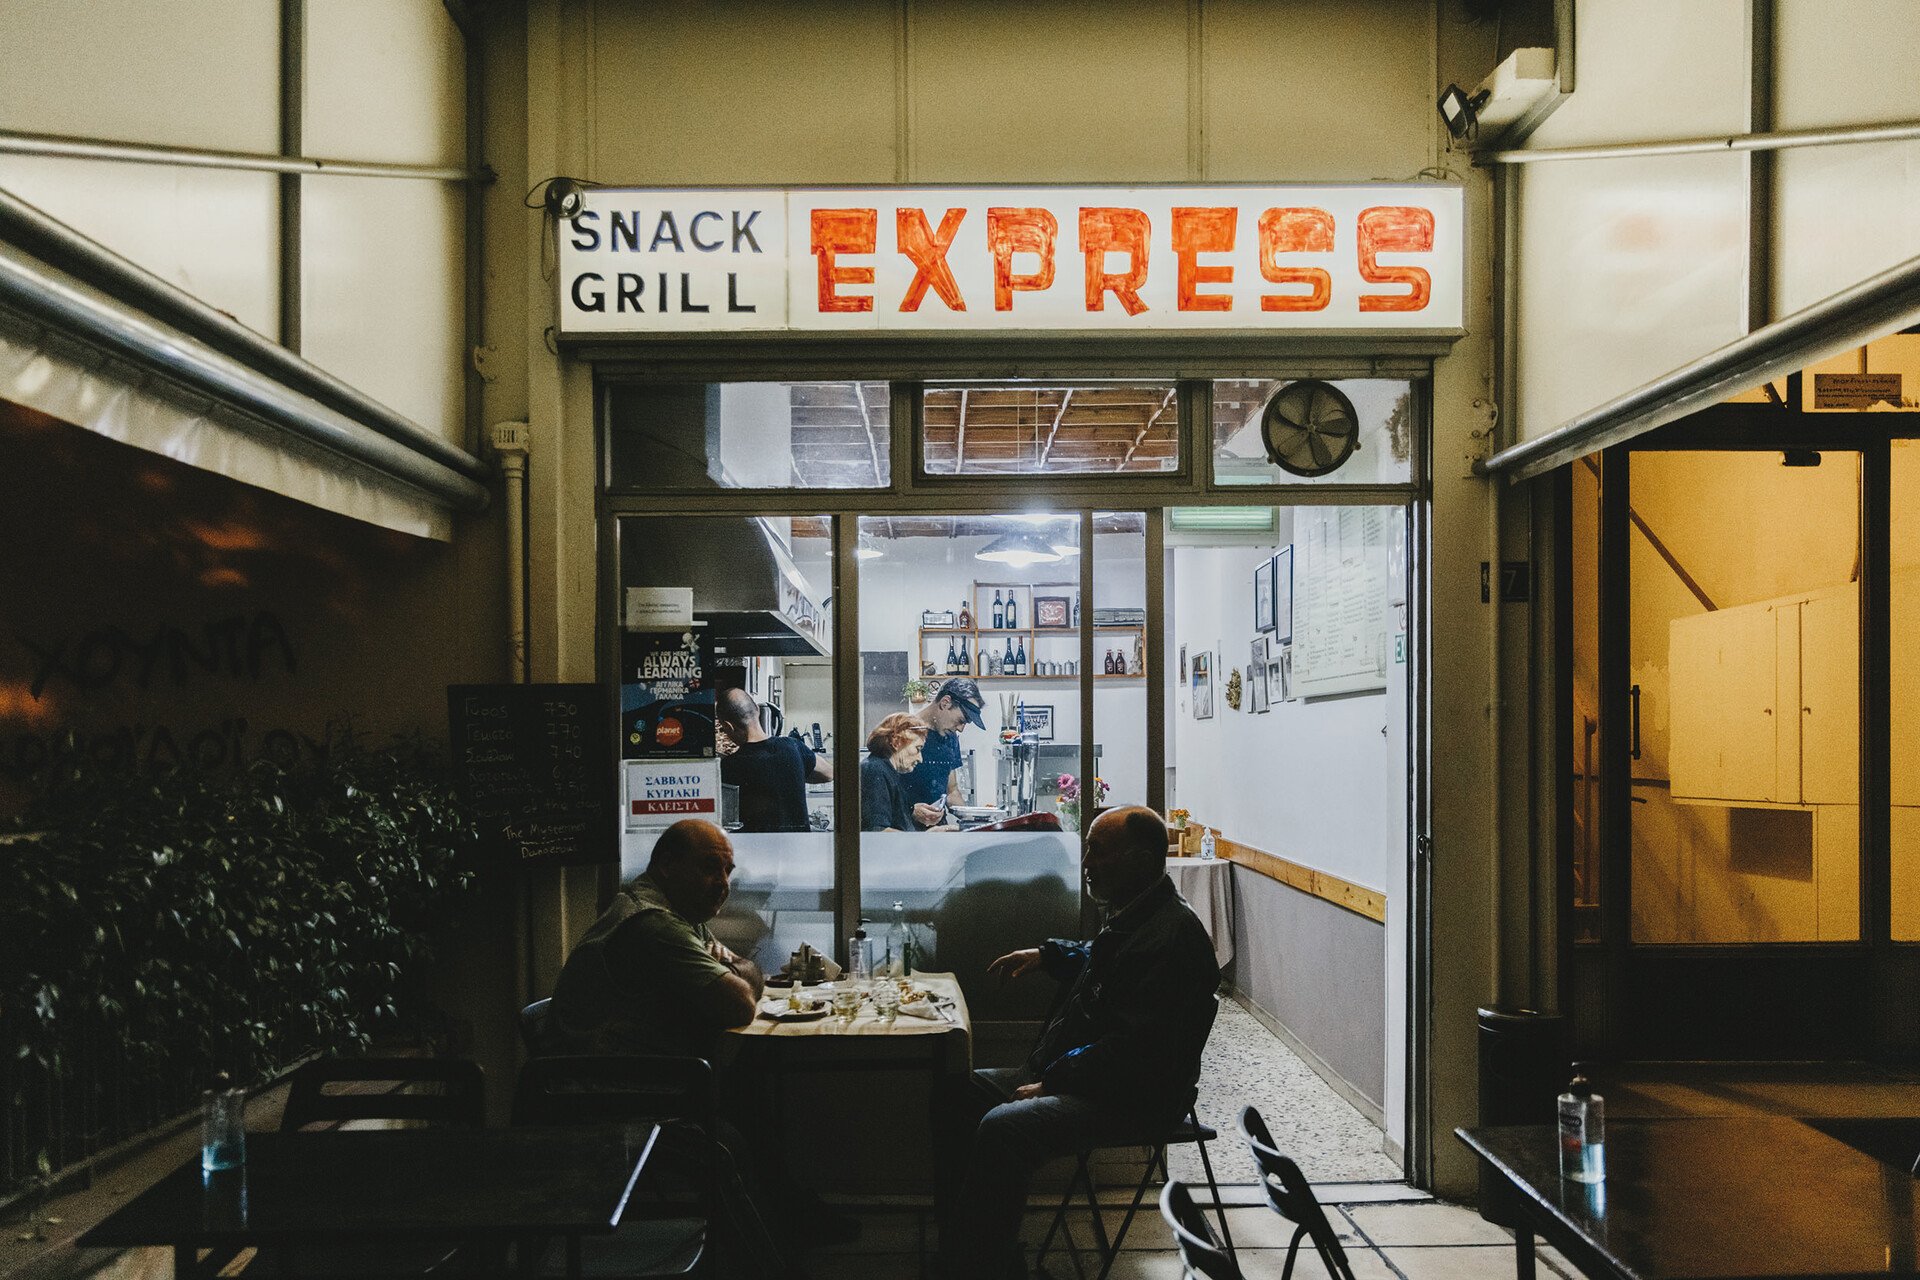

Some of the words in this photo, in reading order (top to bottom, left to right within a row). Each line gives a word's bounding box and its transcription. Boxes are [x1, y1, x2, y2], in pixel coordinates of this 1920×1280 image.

[571, 210, 762, 253] SNACK
[810, 206, 1436, 316] EXPRESS
[571, 272, 757, 313] GRILL
[643, 656, 696, 668] ALWAYS
[637, 667, 702, 679] LEARNING
[656, 727, 680, 736] planet
[645, 775, 701, 786] ΣΑΒΒΑΤΟ
[646, 788, 700, 799] ΚΥΡΙΑΚΗ
[648, 801, 700, 812] ΚΛΕΙΣΤΑ
[502, 824, 523, 841] The
